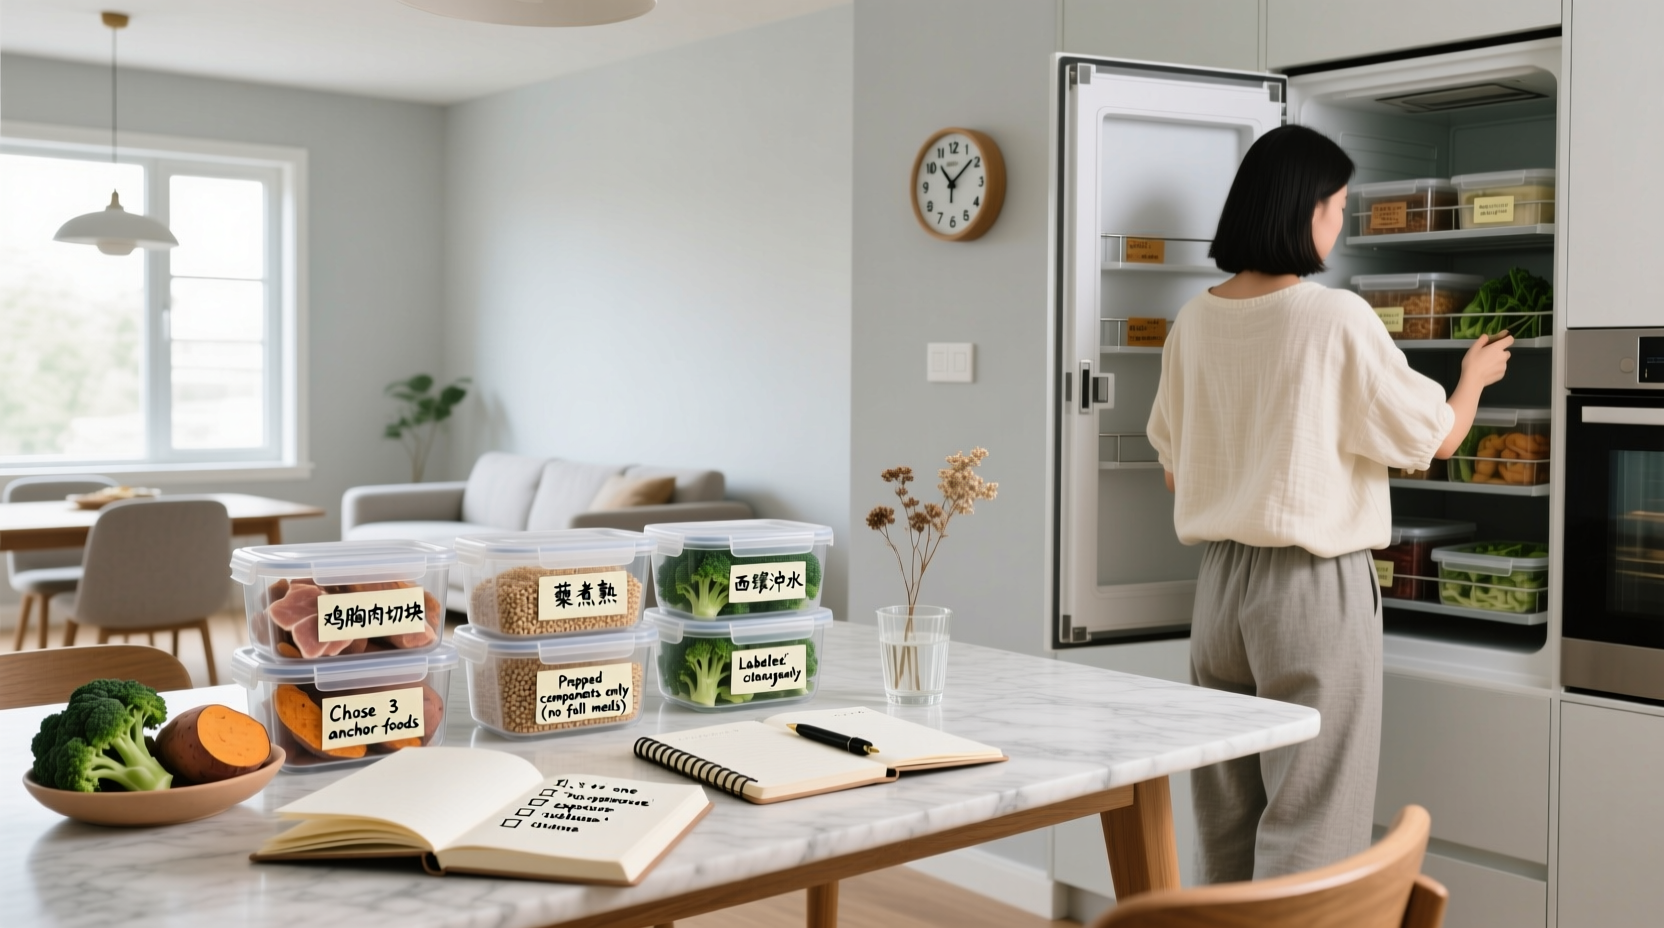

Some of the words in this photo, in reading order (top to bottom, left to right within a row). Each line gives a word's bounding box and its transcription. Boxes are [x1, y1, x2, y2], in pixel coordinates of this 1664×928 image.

[937, 147, 944, 159] 11
[949, 141, 959, 154] 12
[926, 161, 937, 174] 10
[974, 156, 981, 168] 2
[923, 181, 929, 194] 9
[978, 176, 984, 187] 3
[973, 196, 979, 207] 4
[937, 212, 944, 225] 7
[949, 216, 956, 228] 6
[324, 601, 424, 630] 鸡胸肉切块
[329, 704, 377, 722] Chose
[389, 699, 399, 714] 3
[328, 721, 378, 740] anchor
[381, 714, 419, 735] foods
